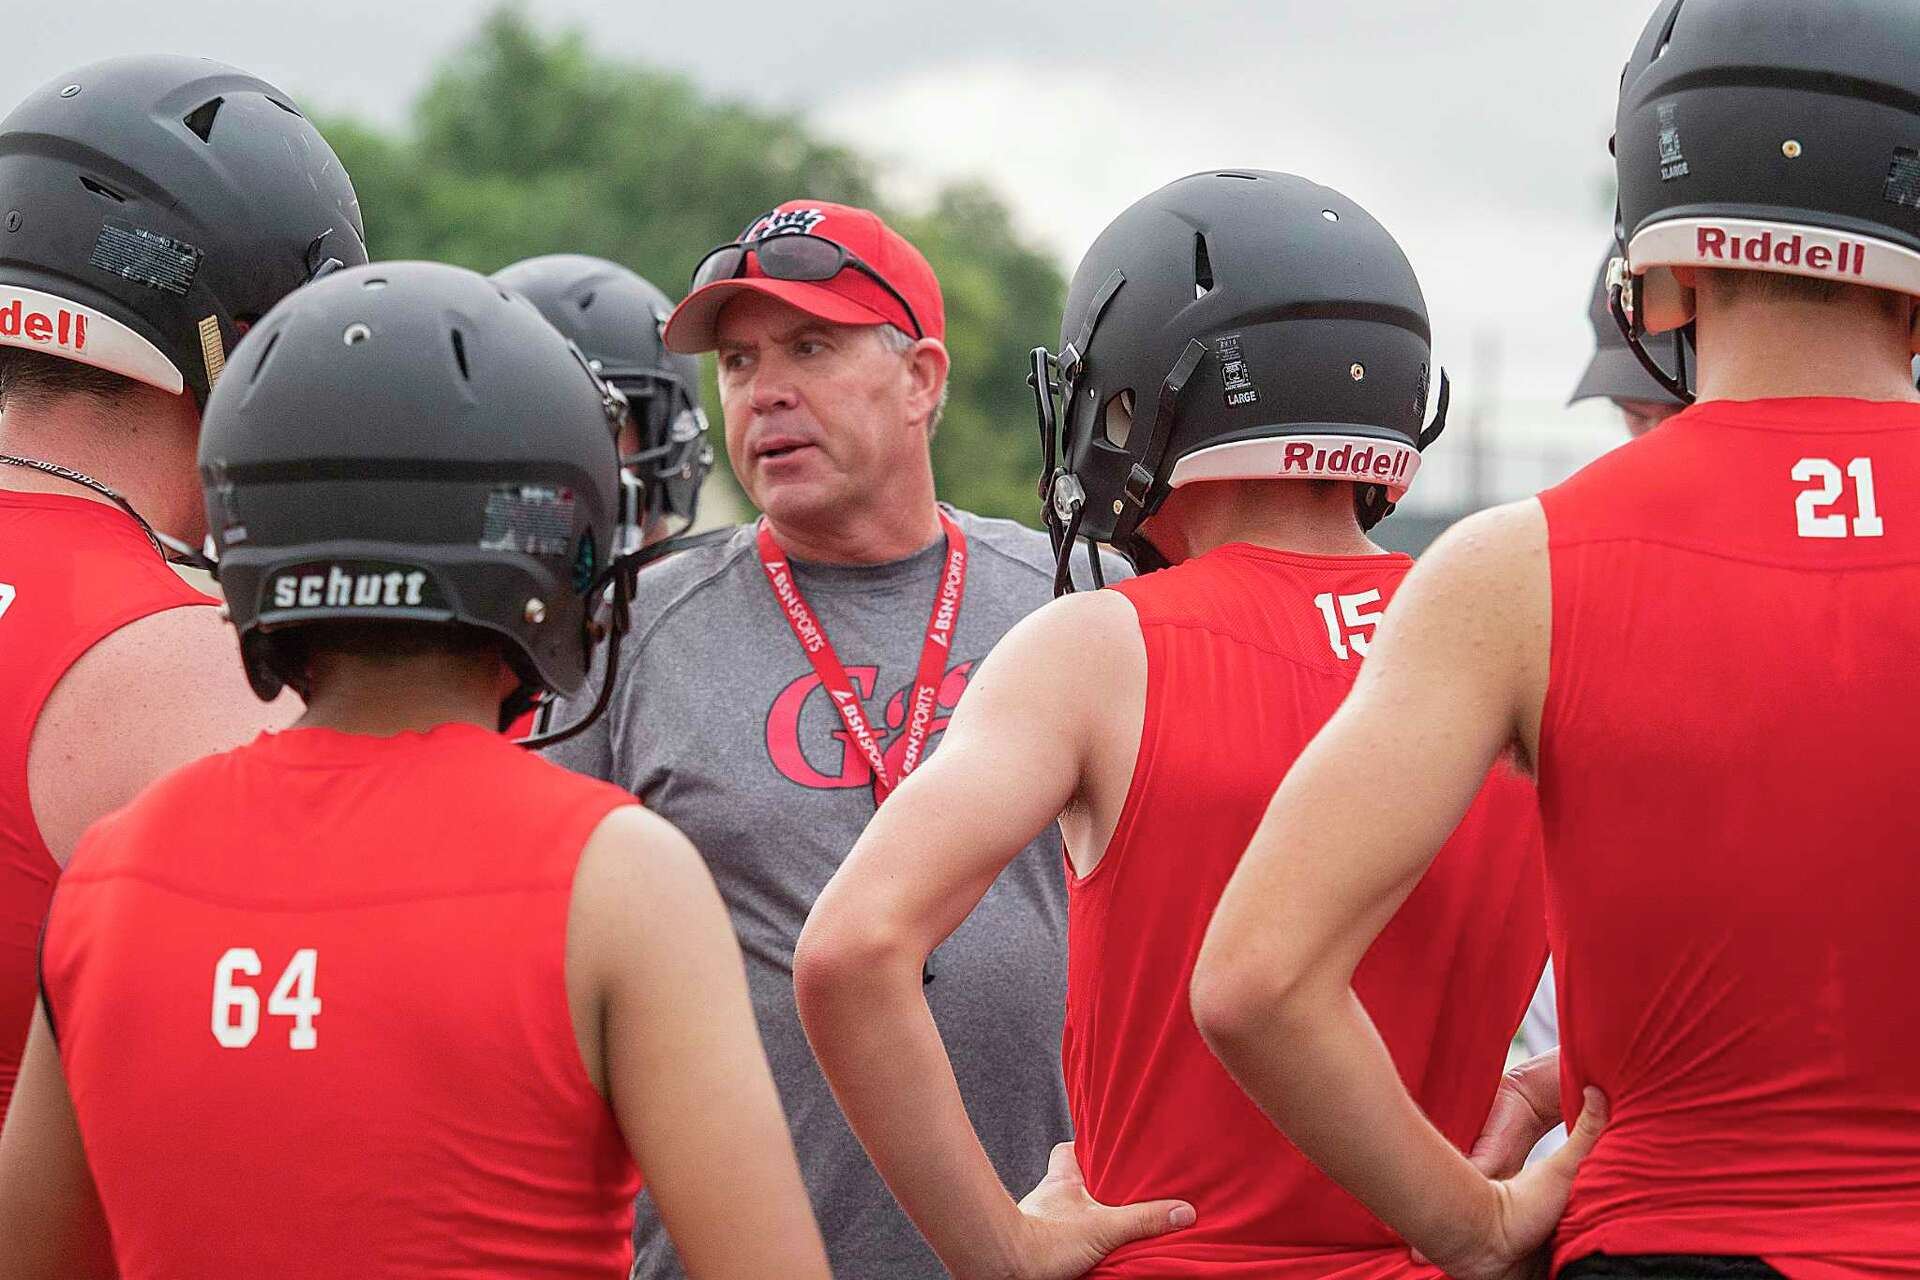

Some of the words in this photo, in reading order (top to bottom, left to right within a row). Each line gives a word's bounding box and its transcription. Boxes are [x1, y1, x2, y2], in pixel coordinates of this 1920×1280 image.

[1696, 226, 1866, 275] Riddell
[1227, 390, 1257, 405] LARGE
[1283, 442, 1410, 479] Riddell
[1791, 457, 1884, 538] 21
[274, 565, 427, 607] schutt
[1313, 587, 1384, 660] 15
[211, 947, 322, 1050] 64
